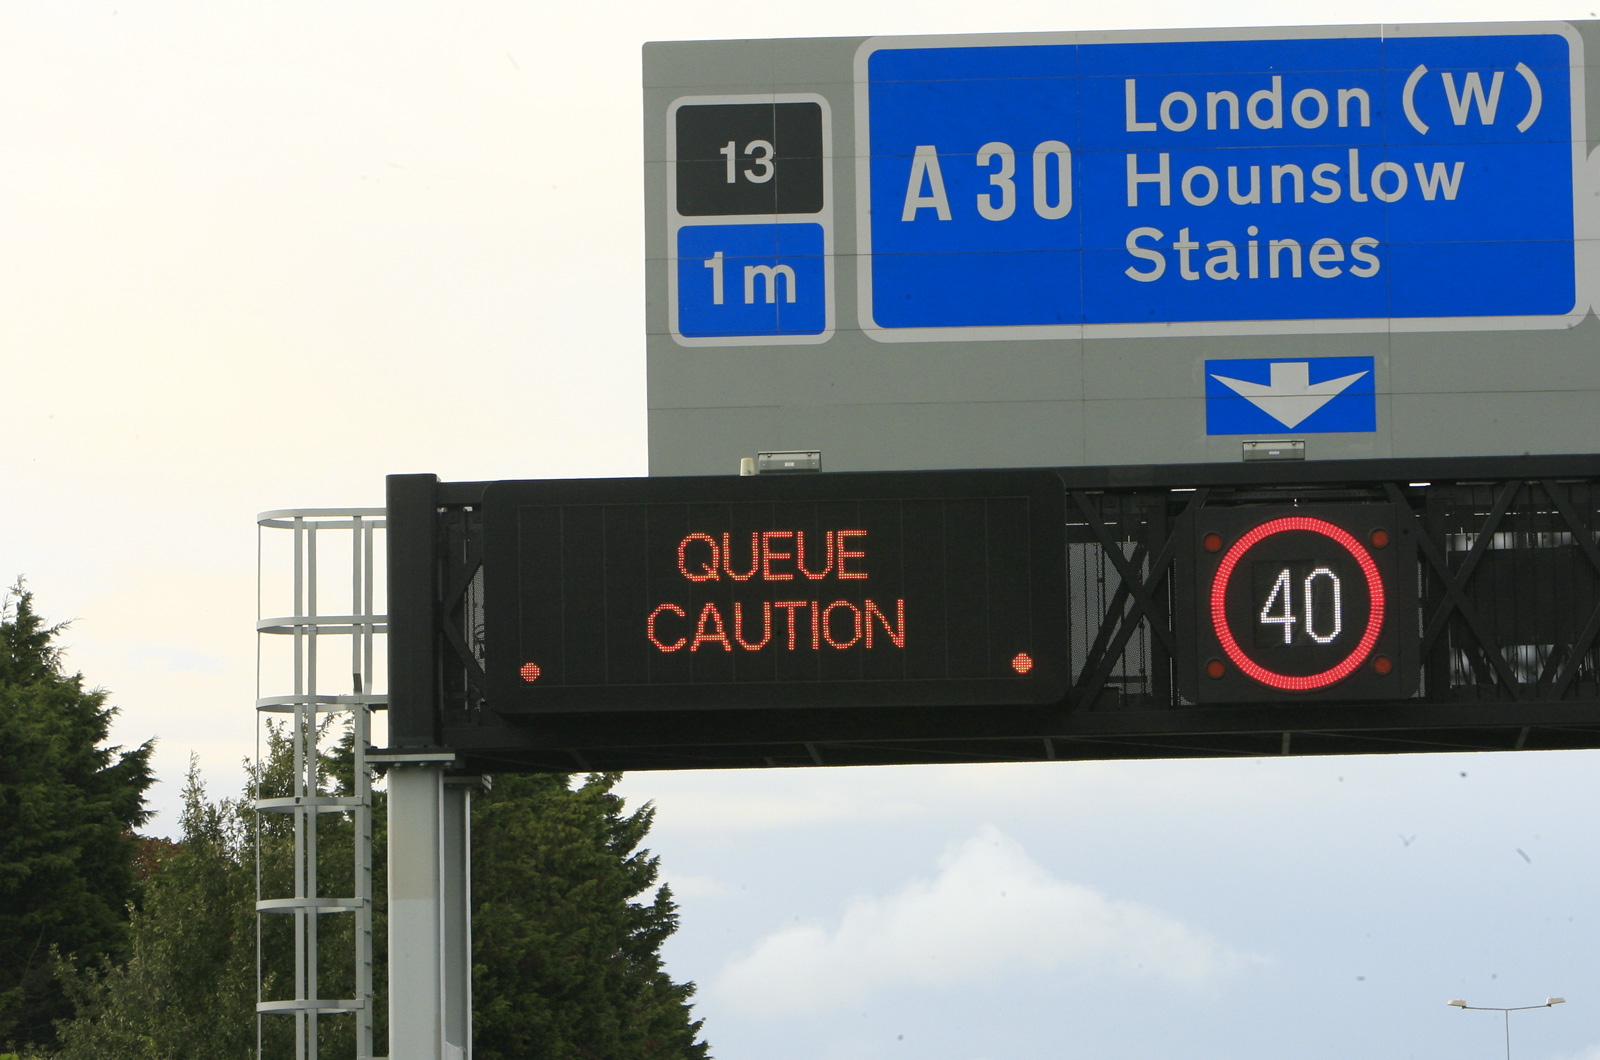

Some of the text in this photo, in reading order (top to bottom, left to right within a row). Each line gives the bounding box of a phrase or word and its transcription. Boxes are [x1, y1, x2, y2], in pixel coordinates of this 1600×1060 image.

[1126, 62, 1542, 134] London (W)
[720, 140, 774, 183] 13
[1127, 149, 1464, 206] Hounslow
[1125, 226, 1379, 282] Staines
[678, 530, 868, 582] QUEUE
[648, 599, 905, 652] CAUTION
[1261, 568, 1341, 643] 40
